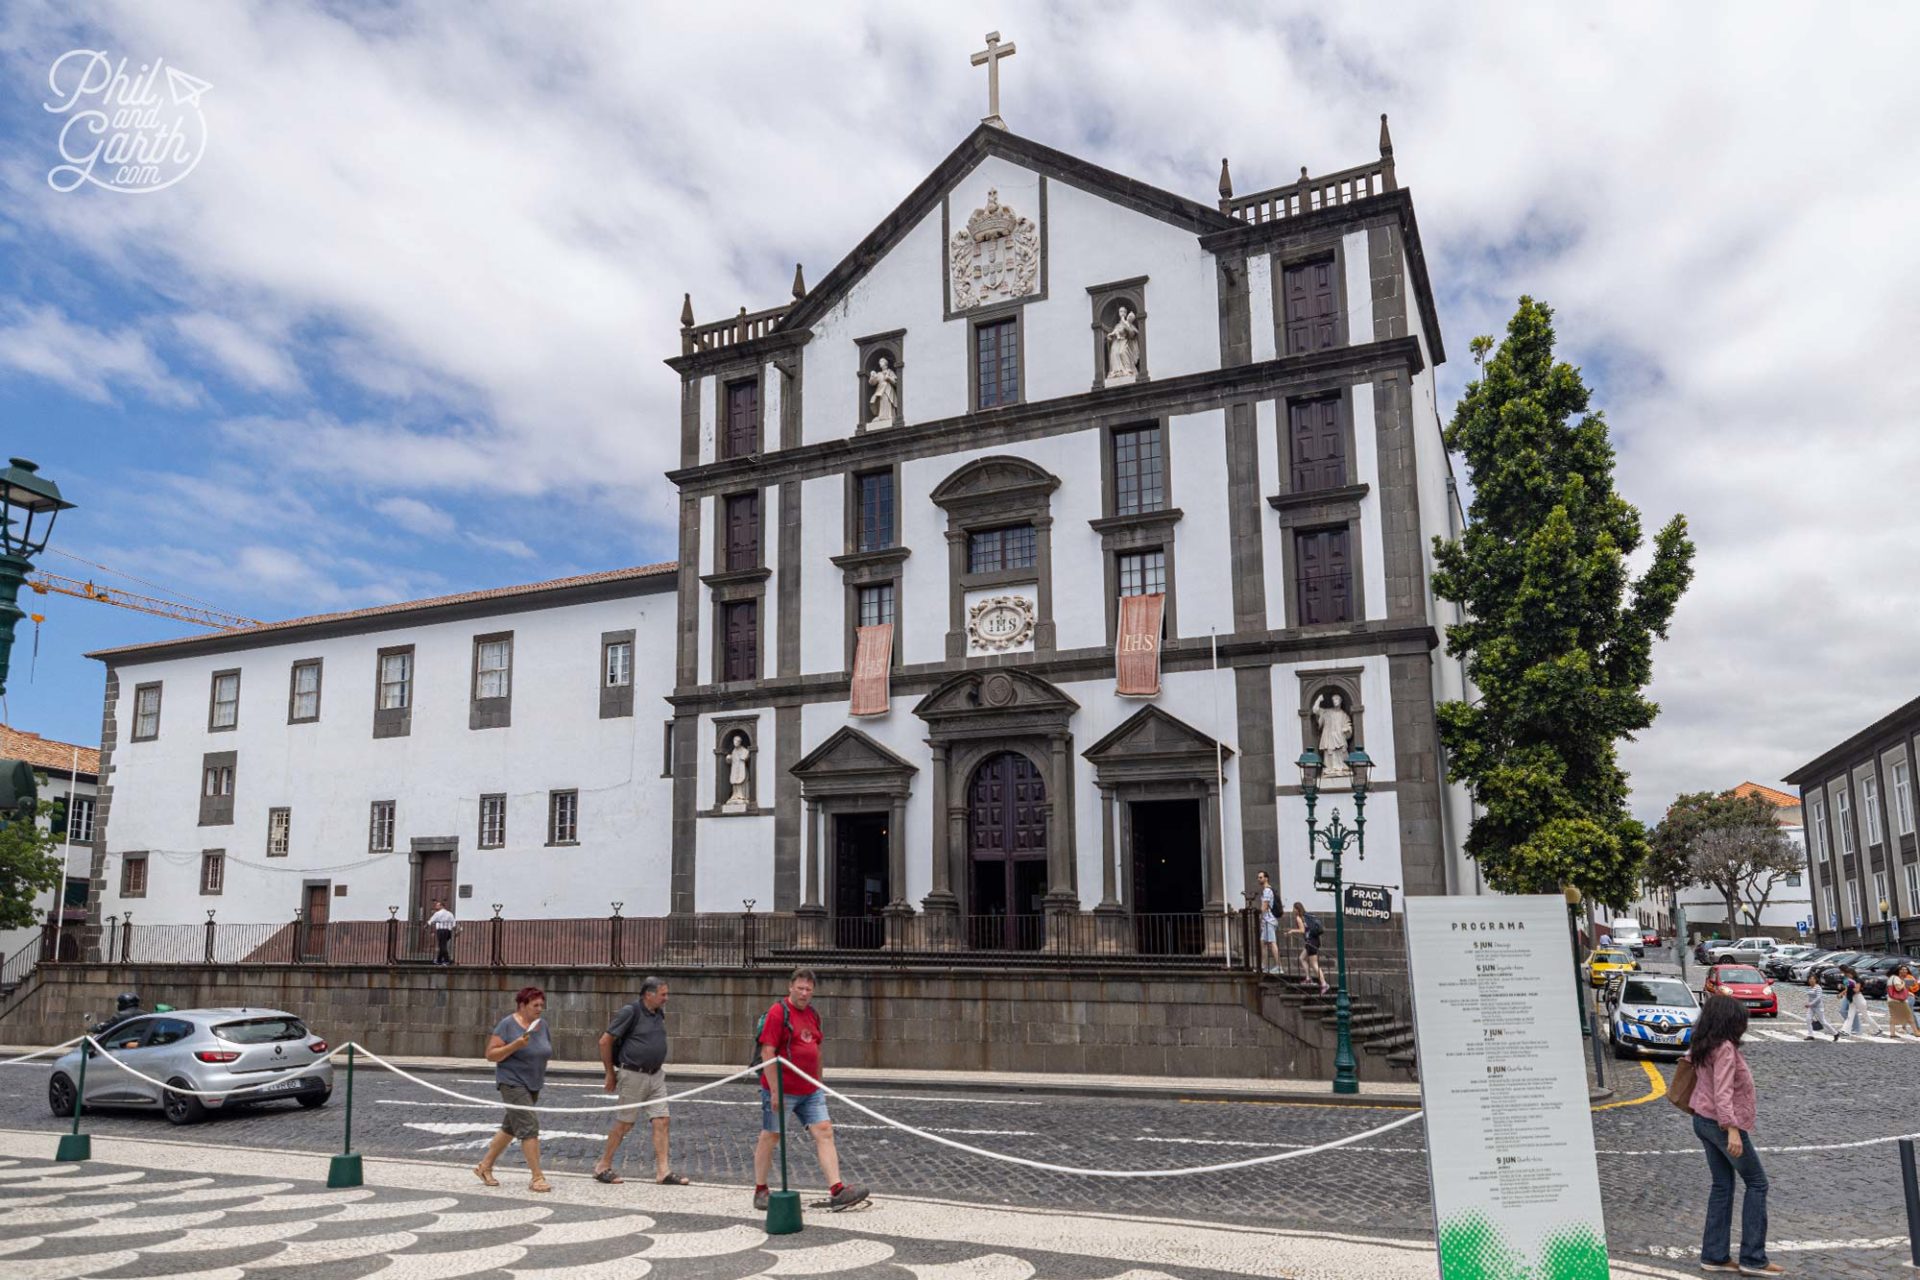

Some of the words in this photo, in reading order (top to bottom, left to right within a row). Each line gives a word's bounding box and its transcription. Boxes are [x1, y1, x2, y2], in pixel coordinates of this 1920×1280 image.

[989, 617, 1017, 632] IHS
[1123, 634, 1154, 652] IHS
[1452, 922, 1525, 931] PROGRAMA
[1480, 941, 1493, 950] JUN
[1482, 964, 1496, 973] JUN
[1490, 1029, 1503, 1038] JUN
[1493, 1066, 1506, 1074] JUN
[1503, 1156, 1516, 1165] JUN
